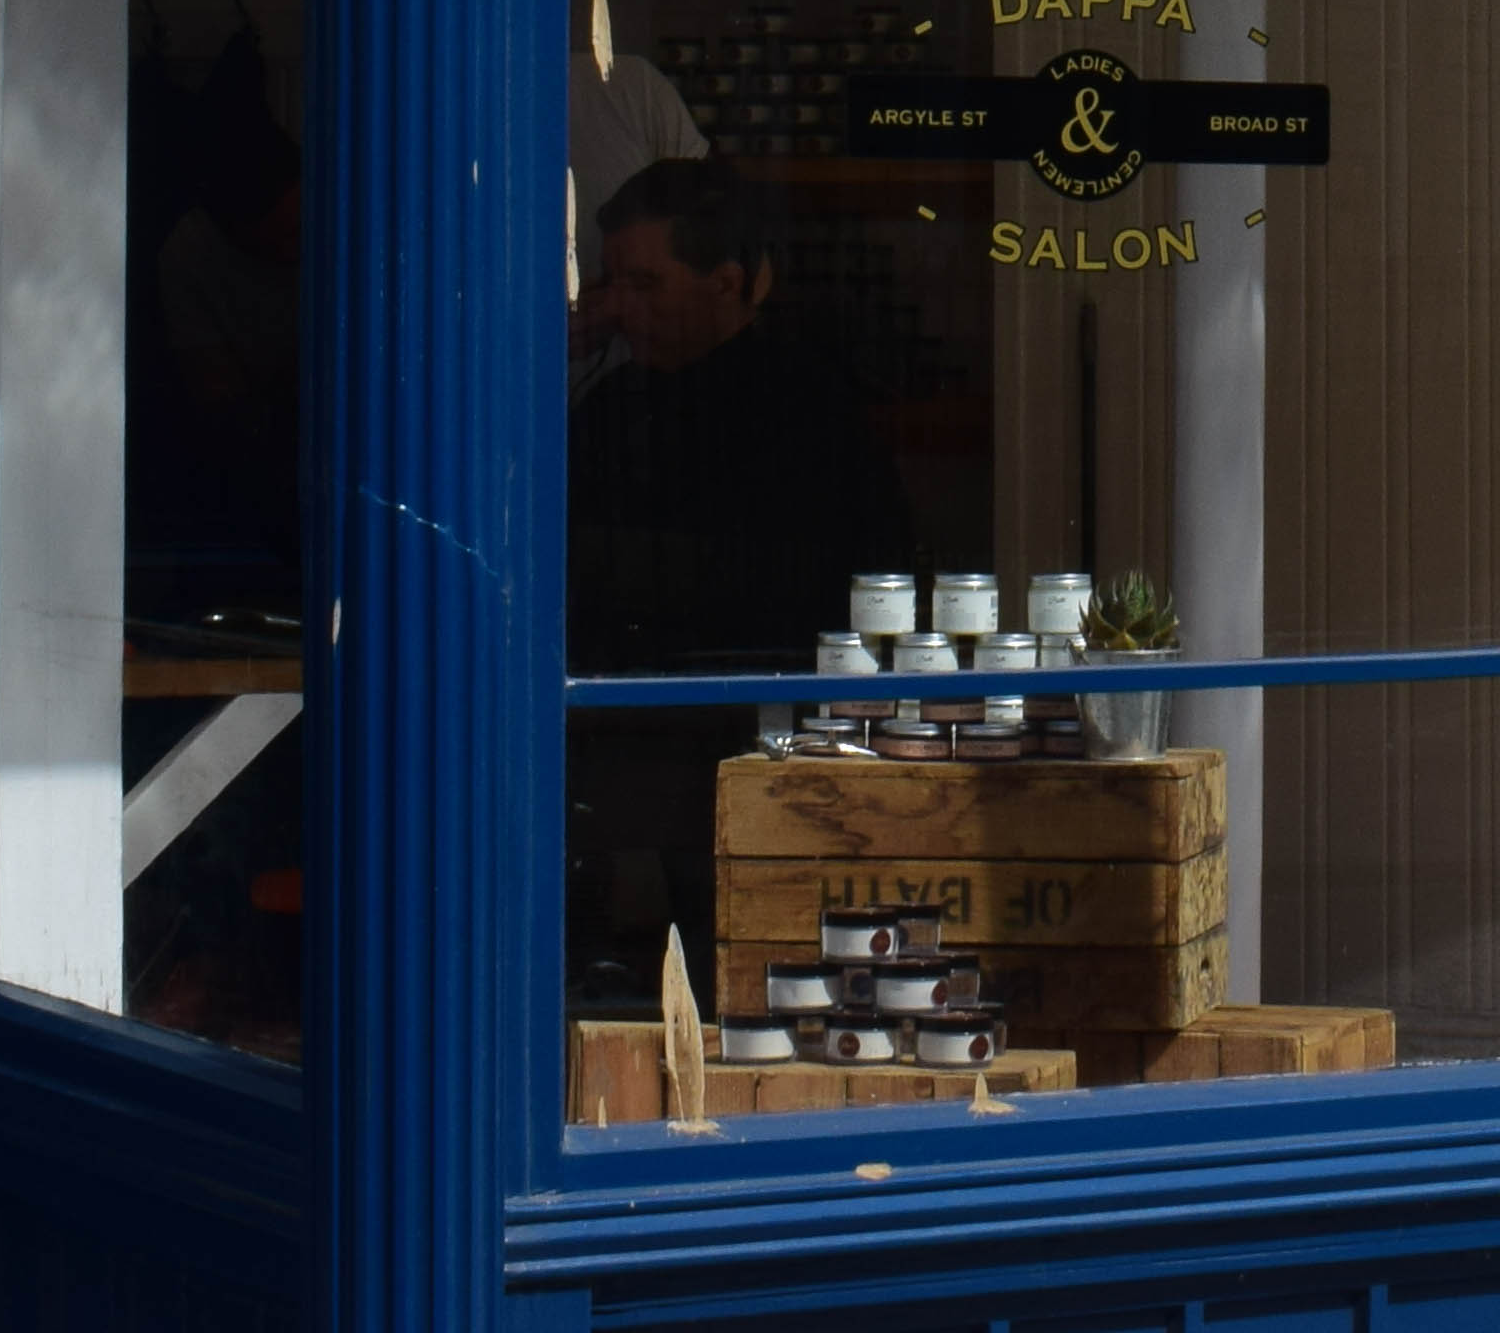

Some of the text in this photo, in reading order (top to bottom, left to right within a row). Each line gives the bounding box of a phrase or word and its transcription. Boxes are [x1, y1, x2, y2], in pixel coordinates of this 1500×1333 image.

[1051, 54, 1126, 84] LADIES
[869, 109, 988, 127] ARGYLE ST
[1060, 87, 1121, 155] &
[1209, 115, 1309, 134] BROAD ST
[1032, 148, 1142, 196] GENTLEMEN
[988, 219, 1199, 272] SALON
